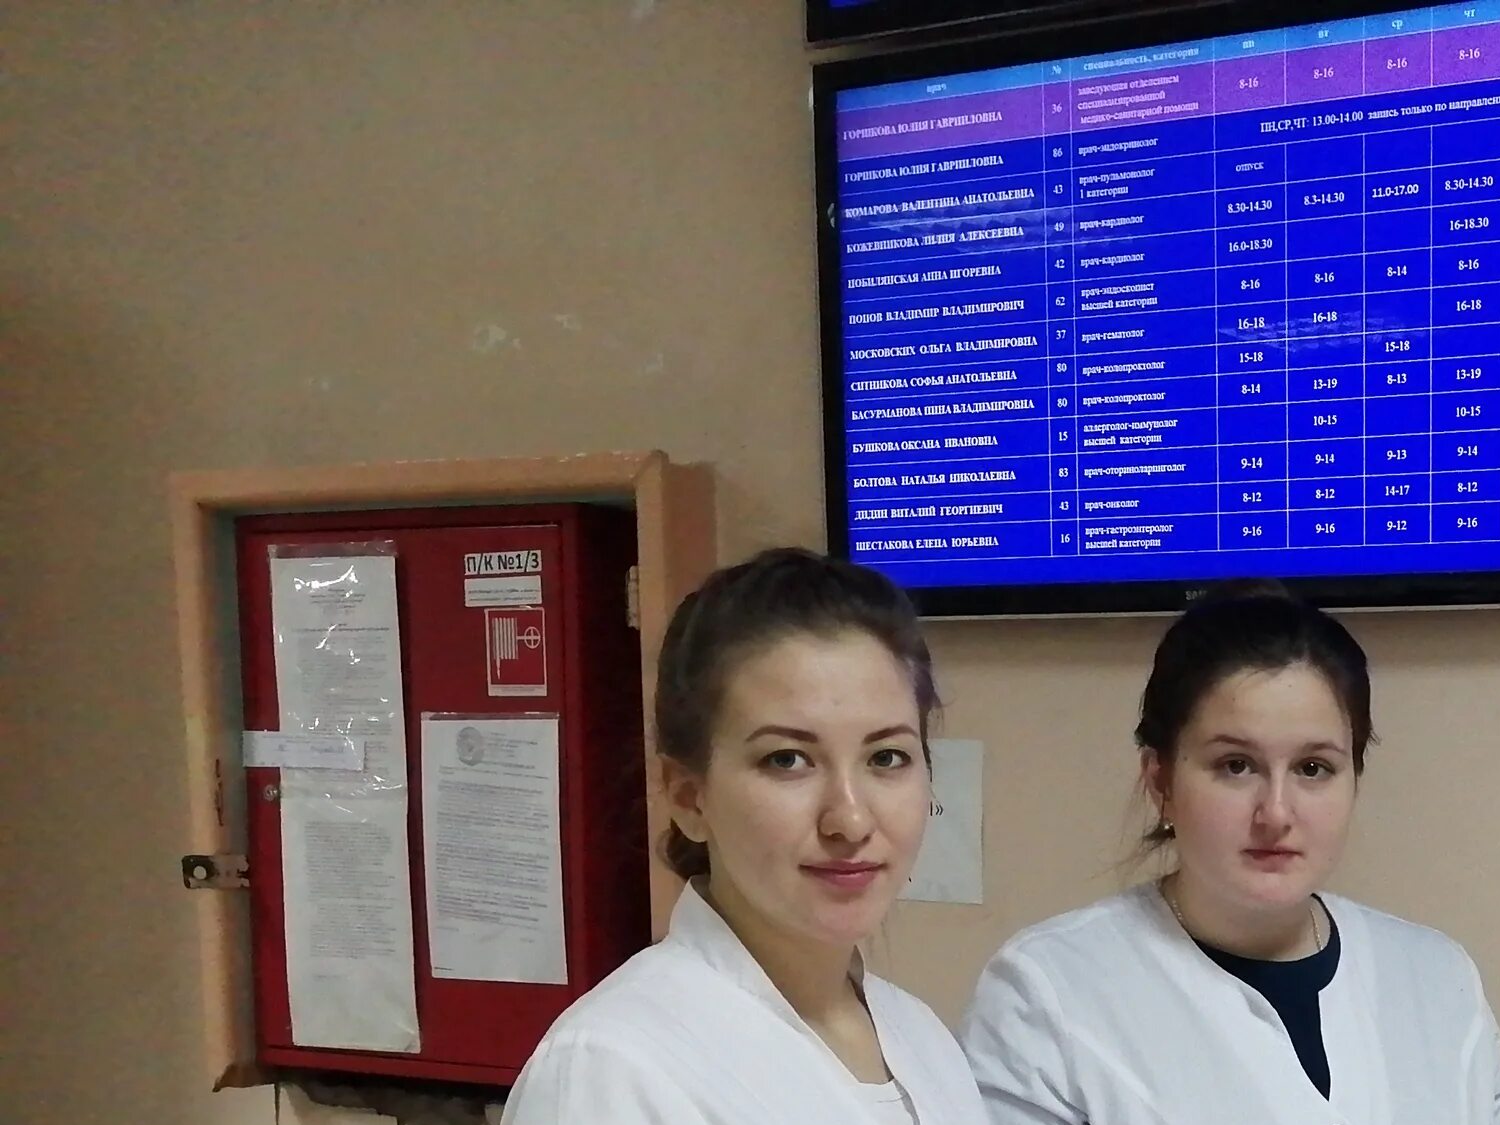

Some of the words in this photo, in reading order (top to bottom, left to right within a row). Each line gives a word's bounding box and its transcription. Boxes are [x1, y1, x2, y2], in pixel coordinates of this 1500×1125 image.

[1240, 77, 1258, 88] 8-16
[1313, 111, 1363, 126] 13.00-14.00
[1368, 109, 1399, 119] запись
[1400, 105, 1433, 115] только
[1435, 103, 1447, 111] по
[1372, 184, 1419, 198] 11.0-17.00
[1228, 200, 1272, 213] 8.30-14.30
[1450, 217, 1489, 231] 16-18.30
[1229, 238, 1272, 252] 16.0-18.30
[1056, 330, 1066, 339] 37
[919, 344, 951, 354] ОЛЬГА
[956, 336, 1038, 351] ВЛАДИМИРОВНА
[1240, 352, 1263, 363] 15-18
[1456, 368, 1481, 380] 13-19
[1456, 406, 1481, 417] 10-15
[1059, 431, 1068, 441] 15
[1315, 454, 1335, 464] 9-14
[1385, 485, 1410, 496] 14-17
[1243, 526, 1262, 536] 9-16
[856, 540, 914, 551] ШЕСТАКОВА
[916, 539, 948, 548] ЕЛЕНА
[951, 537, 999, 547] ЮРЬЕВНА
[1061, 534, 1070, 543] 16
[466, 553, 494, 574] П/К
[497, 550, 540, 572] №1/3
